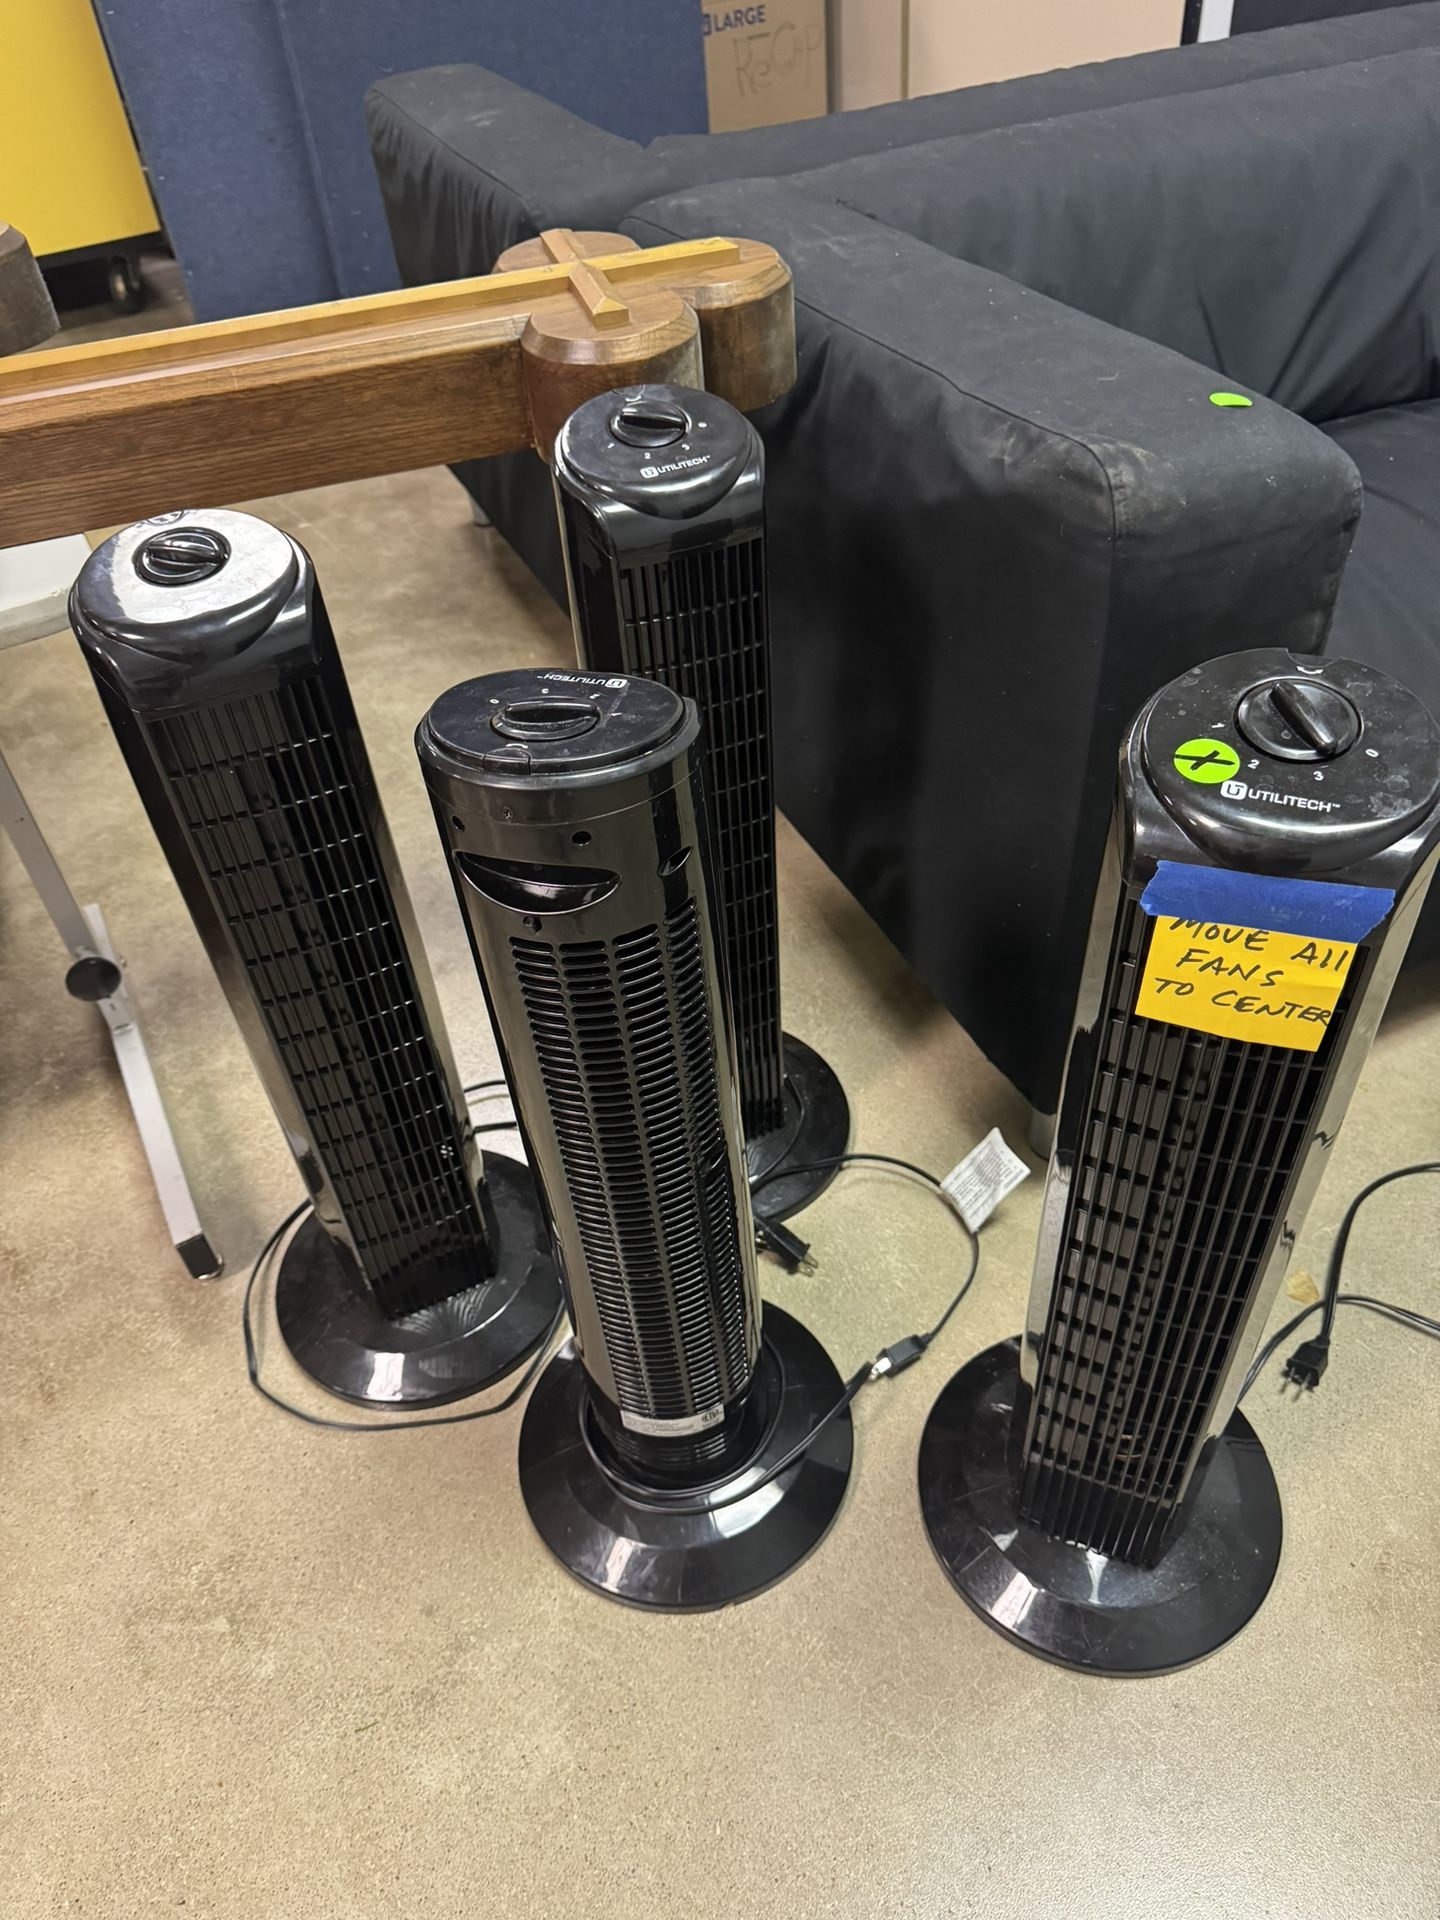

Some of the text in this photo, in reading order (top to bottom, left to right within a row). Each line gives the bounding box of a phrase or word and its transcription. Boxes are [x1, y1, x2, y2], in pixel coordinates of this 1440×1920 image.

[713, 4, 767, 32] LARGE
[681, 443, 690, 451] 3
[1247, 759, 1259, 769] 2
[1313, 770, 1324, 781] 3
[1170, 917, 1269, 952] MOVE
[1175, 948, 1284, 989] FANS
[1154, 977, 1332, 1026] TO CENTER
